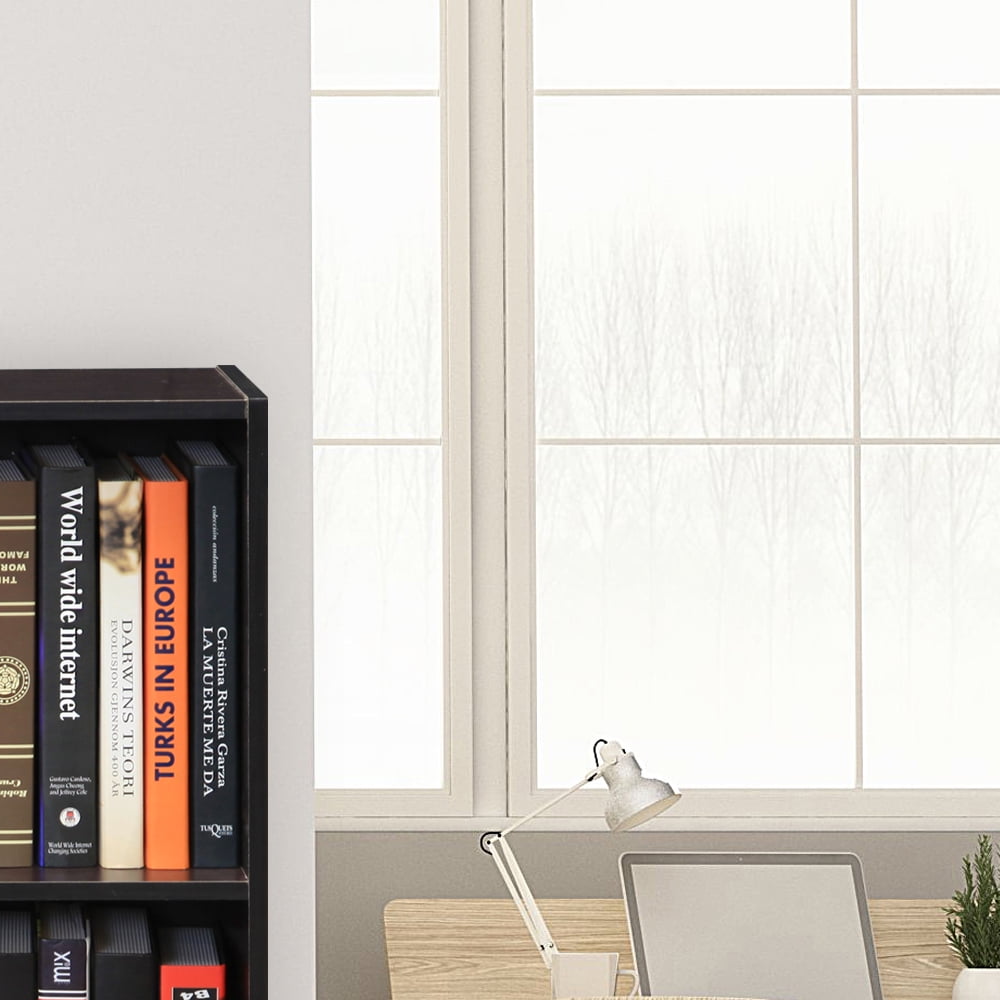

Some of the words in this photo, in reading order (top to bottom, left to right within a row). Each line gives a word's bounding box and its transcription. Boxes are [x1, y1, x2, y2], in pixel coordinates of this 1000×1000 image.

[60, 486, 84, 563] World
[59, 568, 83, 623] wide
[154, 557, 176, 655] EUROPE
[110, 620, 119, 689] EVOLUSJON
[202, 626, 214, 651] LA
[216, 626, 228, 686] Cristina
[59, 627, 83, 721] internet
[121, 620, 134, 724] DARWINS
[154, 664, 175, 691] IN
[202, 655, 214, 734] MUERTE
[110, 692, 119, 753] GJENNOM
[154, 701, 175, 781] TURKS
[217, 689, 228, 740] Rivera
[111, 755, 119, 777] 400
[122, 731, 135, 797] TEORI
[203, 739, 214, 766] ME
[217, 743, 229, 788] Garza
[203, 769, 214, 797] DA
